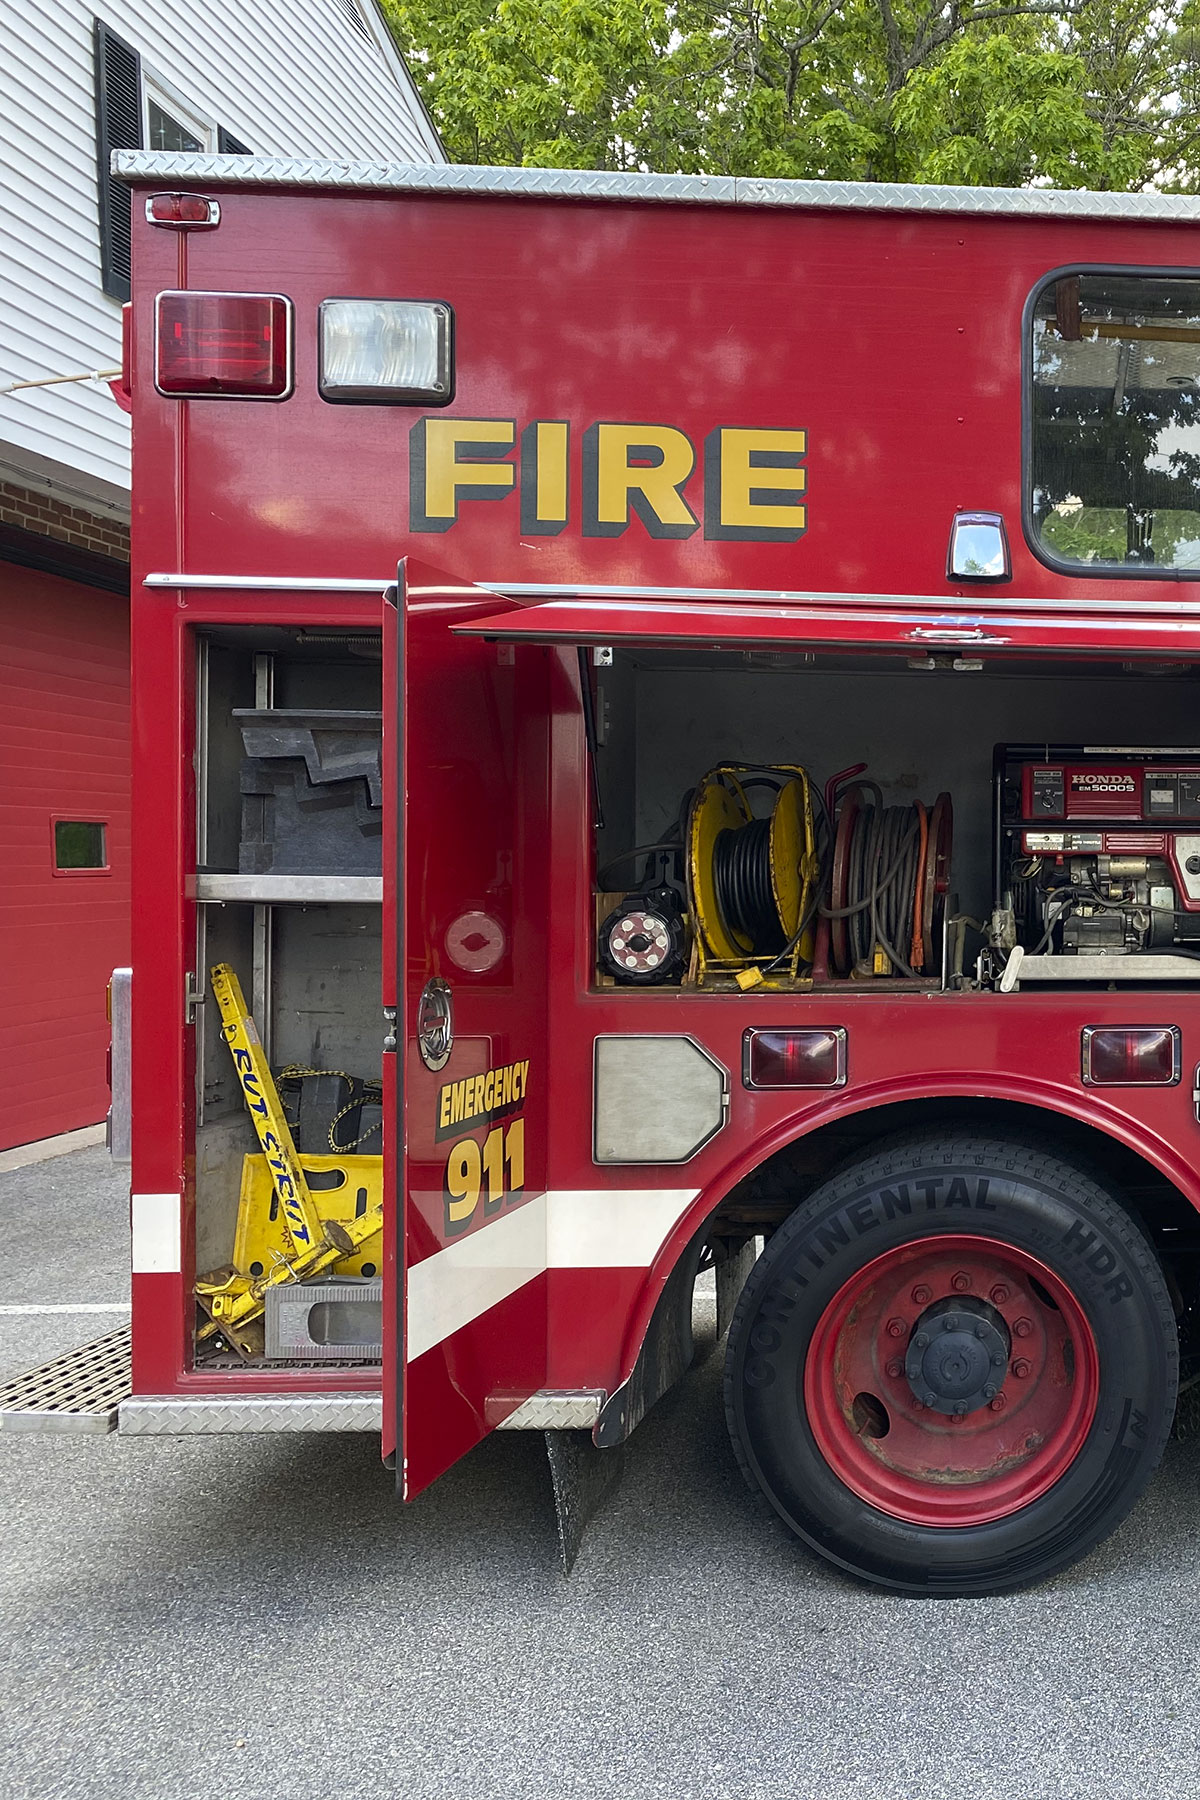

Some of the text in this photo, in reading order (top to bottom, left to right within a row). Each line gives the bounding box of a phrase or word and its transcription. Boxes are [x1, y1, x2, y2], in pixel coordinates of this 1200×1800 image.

[409, 416, 809, 542] FIRE
[1071, 774, 1136, 784] HONDA
[1091, 784, 1135, 792] 5000S
[436, 1059, 530, 1135] EMERGENCY
[445, 1117, 525, 1228] 911
[744, 1177, 997, 1388] CONTINENTAL
[1062, 1219, 1135, 1305] HDR
